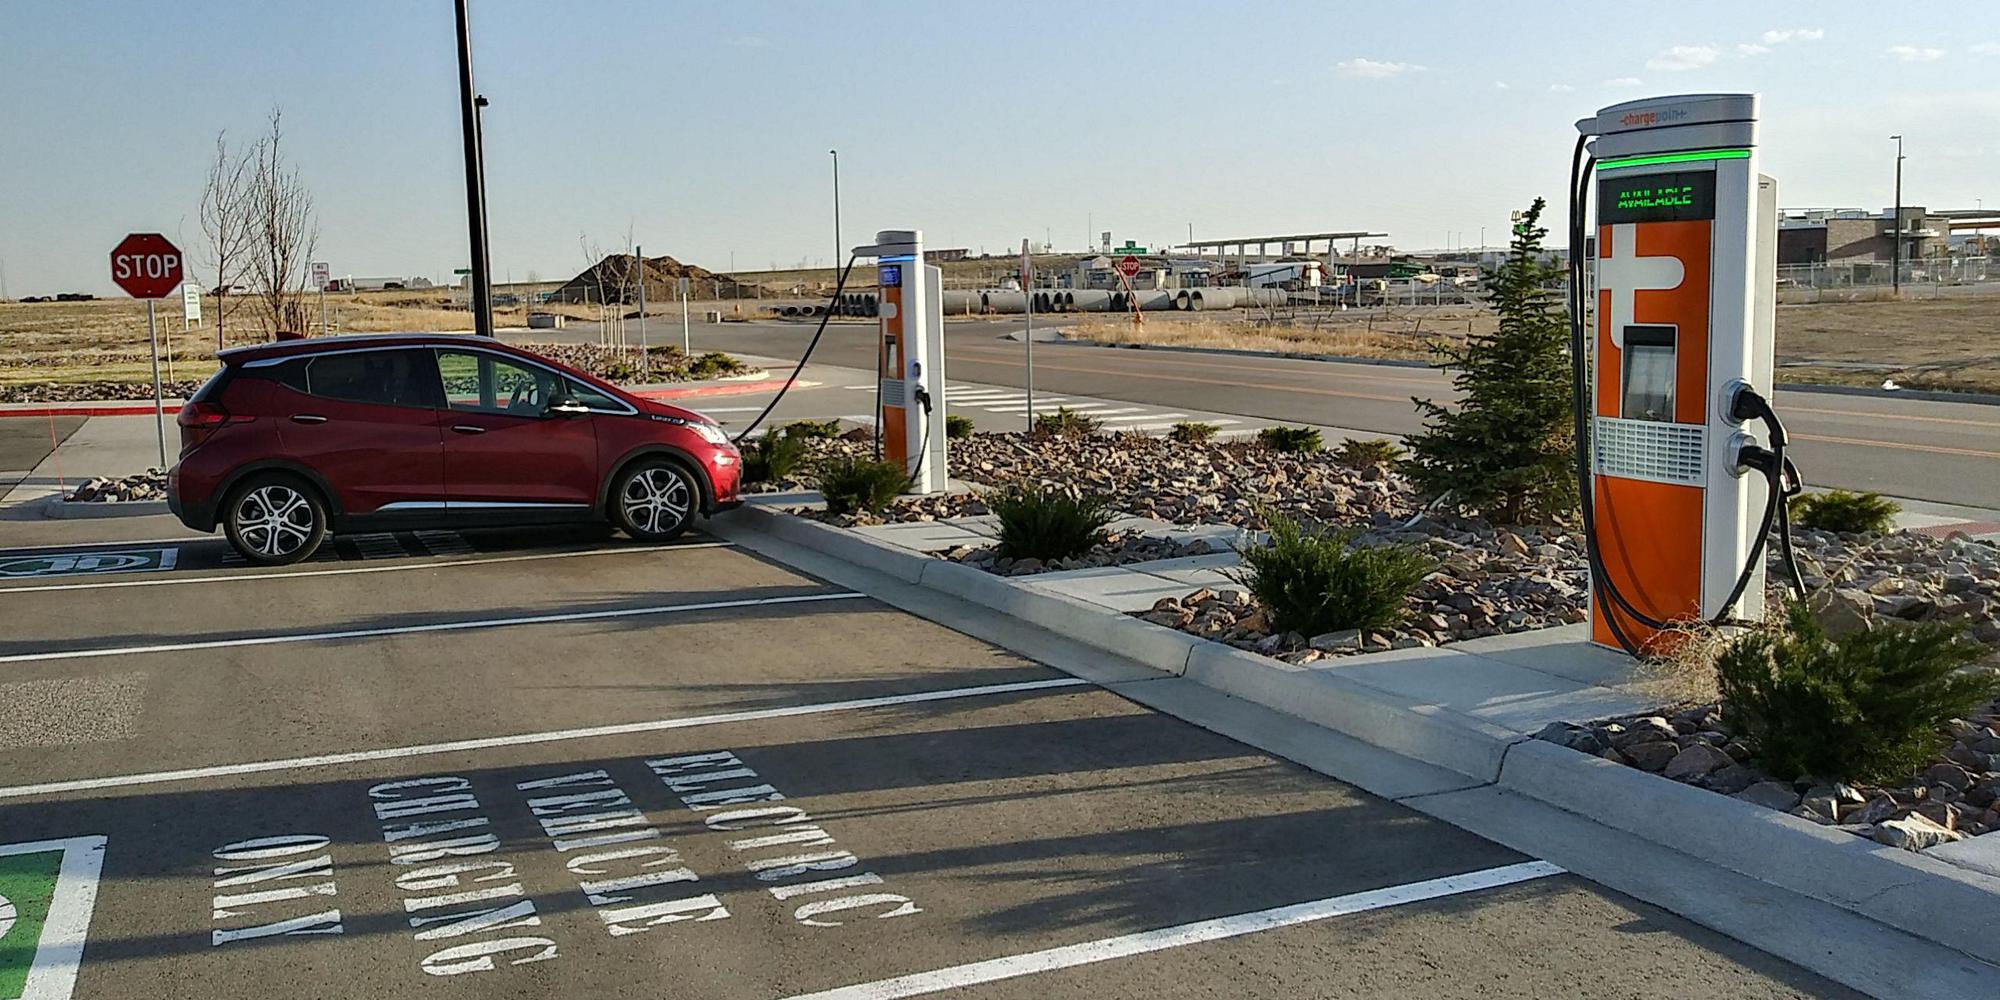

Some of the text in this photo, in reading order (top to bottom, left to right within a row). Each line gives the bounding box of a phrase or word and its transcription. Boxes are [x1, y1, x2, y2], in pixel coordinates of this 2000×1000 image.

[1618, 187, 1692, 209] AVAILABLE
[116, 254, 178, 279] STOP
[1123, 262, 1139, 271] STOP
[212, 835, 344, 945] ONLY
[368, 776, 562, 976] CHARGING
[516, 769, 731, 936] VEHICLE
[644, 751, 923, 928] ELECTRIC
